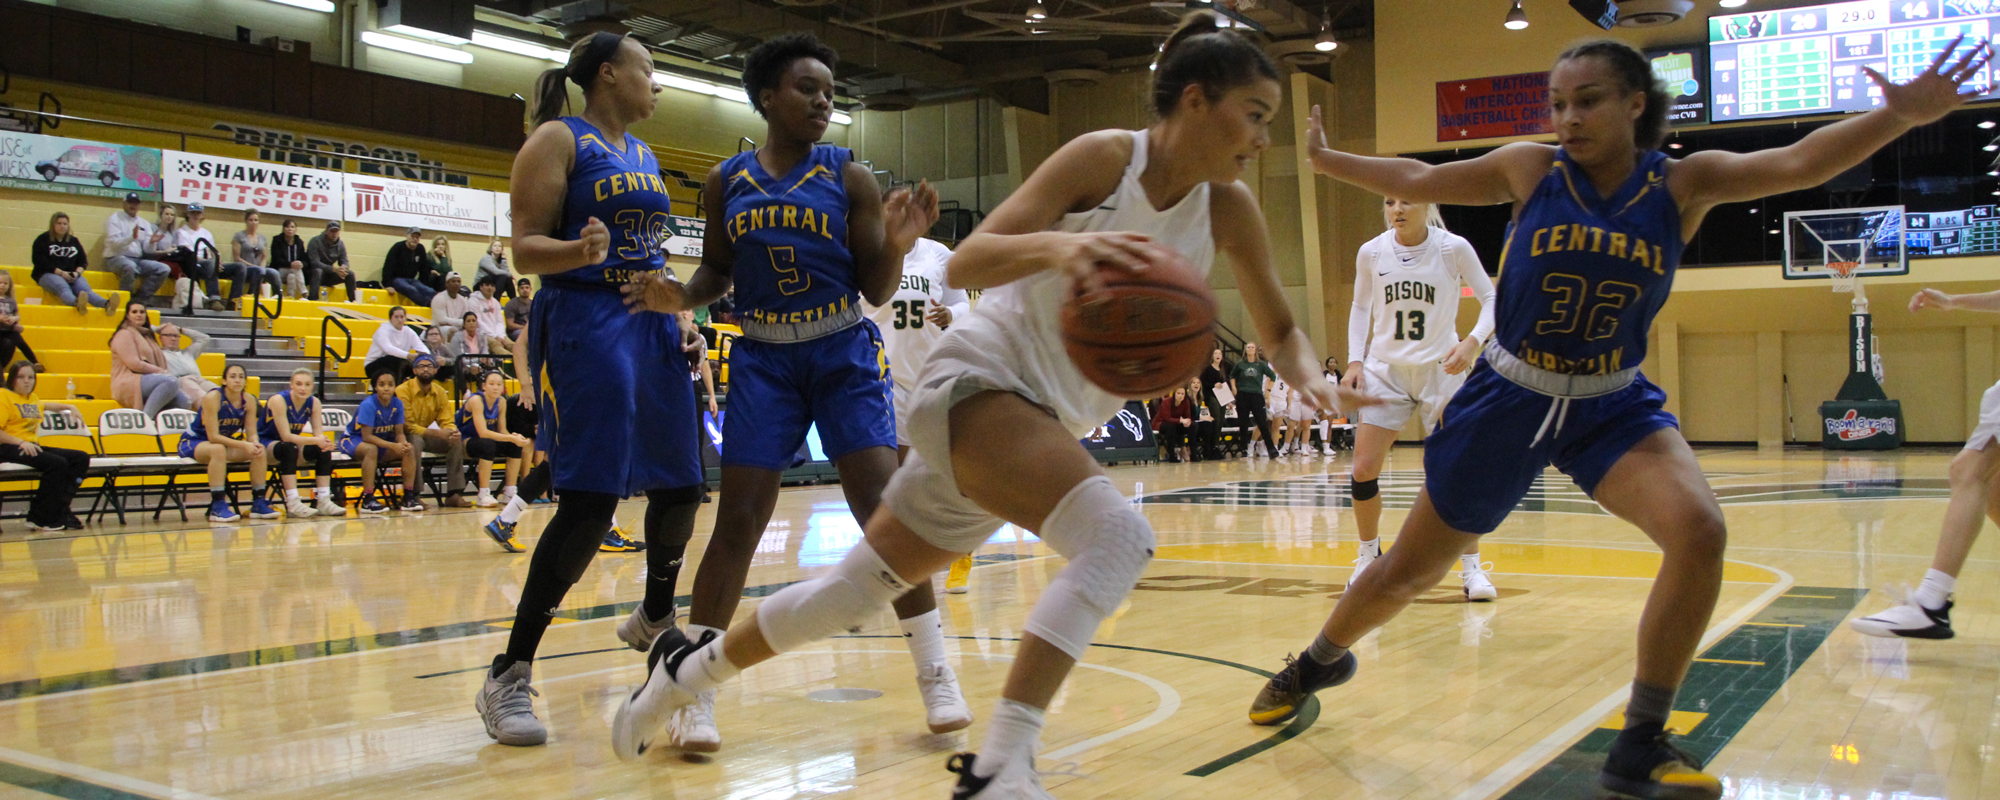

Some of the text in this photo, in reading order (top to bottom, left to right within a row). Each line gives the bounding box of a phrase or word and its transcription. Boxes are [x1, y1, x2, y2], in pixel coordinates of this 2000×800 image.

[1842, 9, 1875, 23] 29.0
[1901, 1, 1929, 19] 14
[1791, 13, 1817, 31] 20
[1770, 56, 1778, 64] 2
[1849, 46, 1869, 56] 1ST
[1722, 72, 1730, 82] 5
[1464, 90, 1549, 109] INTERCOLLE
[1771, 102, 1779, 110] 2
[1441, 110, 1517, 127] BASKETBALL
[1723, 106, 1731, 116] 4
[198, 161, 313, 189] SHAWNEE
[180, 178, 328, 212] PITTSTOP
[386, 186, 413, 198] NOBLE
[727, 205, 833, 244] CENTRAL
[615, 209, 668, 260] 30
[1530, 223, 1665, 276] CENTRAL
[767, 245, 811, 296] 5
[1385, 281, 1435, 305] BISON
[744, 293, 849, 325] HRISTIAN
[892, 300, 925, 330] 35
[1535, 272, 1643, 342] 32
[1395, 310, 1425, 341] 13
[1855, 315, 1866, 373] BISON
[1279, 382, 1284, 391] 5
[105, 412, 146, 430] OBU
[1847, 428, 1872, 438] DINER
